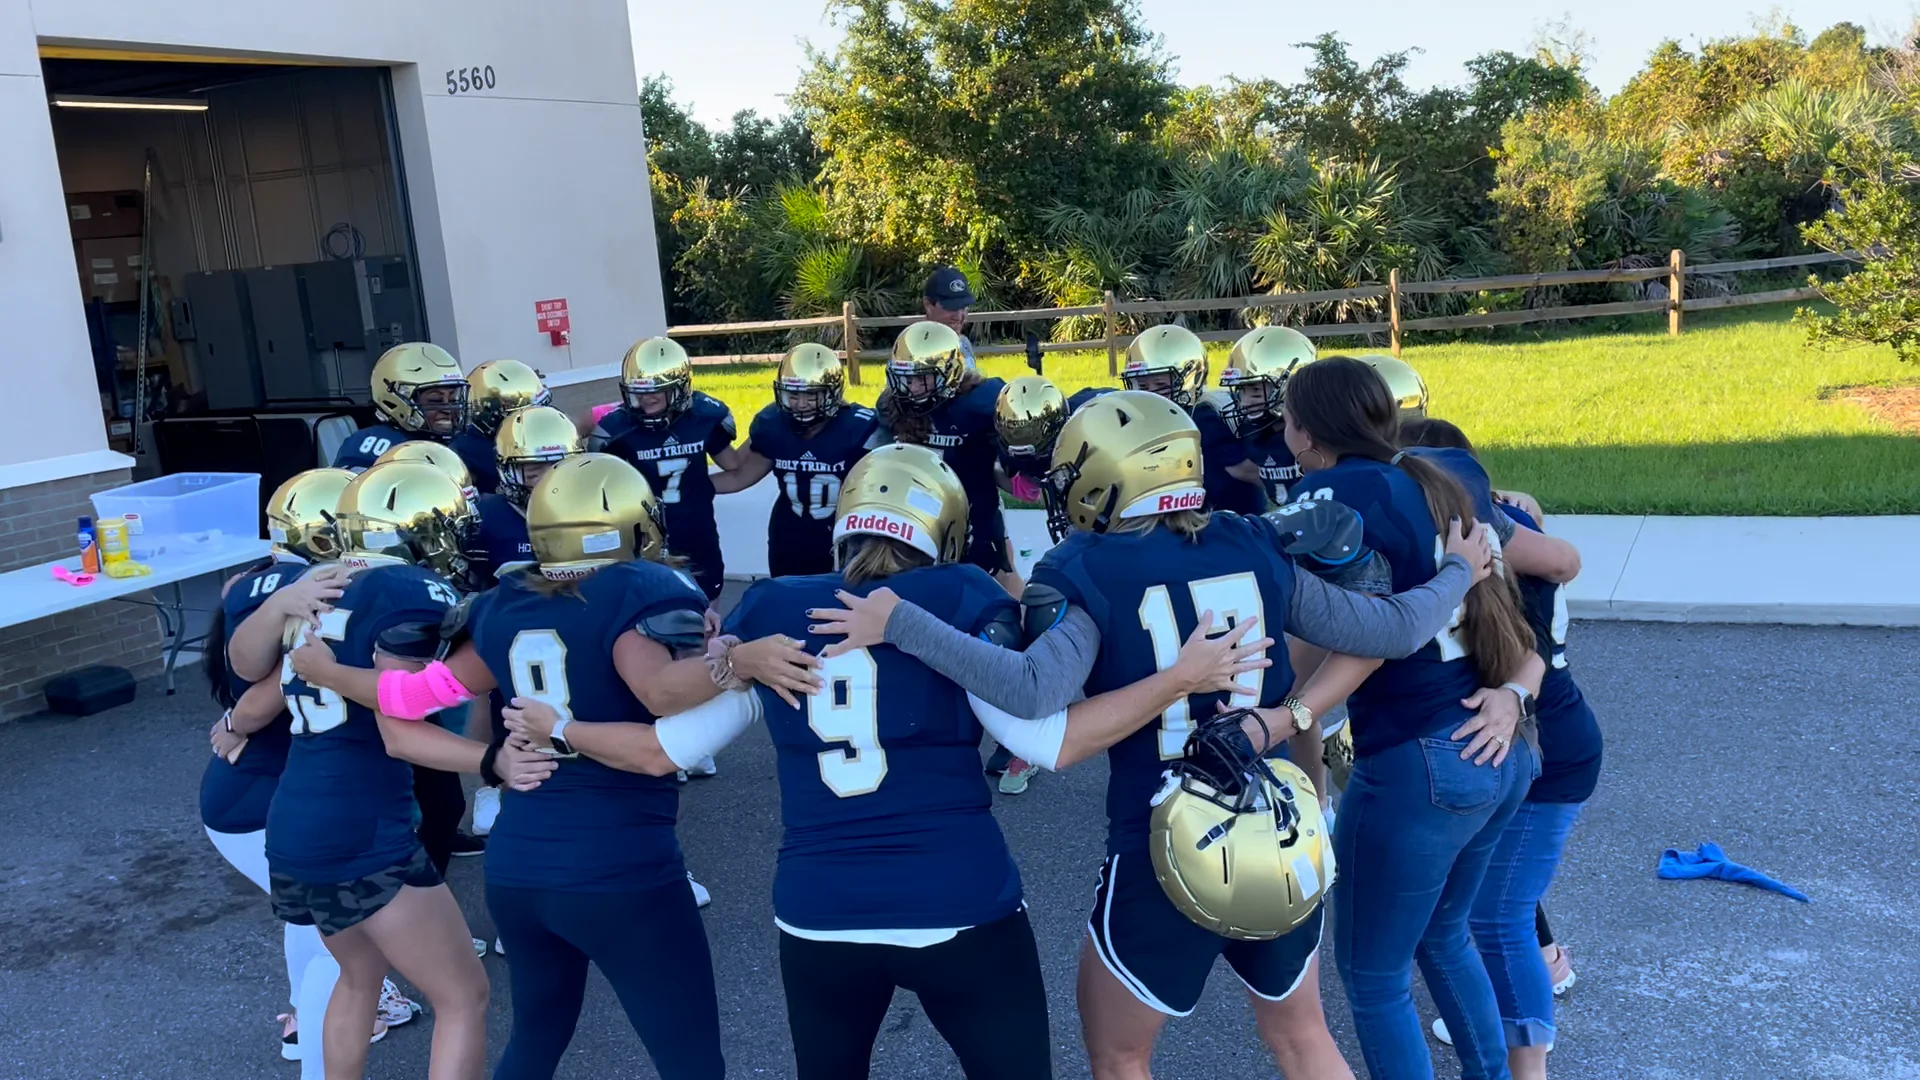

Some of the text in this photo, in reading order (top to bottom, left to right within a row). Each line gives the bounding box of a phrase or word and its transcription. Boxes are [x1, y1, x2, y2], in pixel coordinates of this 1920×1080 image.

[446, 64, 496, 95] 5560
[359, 436, 391, 456] 80
[636, 440, 705, 461] HOLY TRINITY
[775, 458, 846, 473] HOLY TRINITY
[656, 458, 689, 504] 7
[783, 472, 841, 520] 10
[1158, 492, 1205, 511] Ridde
[845, 514, 914, 541] Riddell
[517, 543, 532, 553] HO
[249, 573, 282, 598] 18
[1138, 571, 1266, 761] 17
[807, 644, 888, 798] 9
